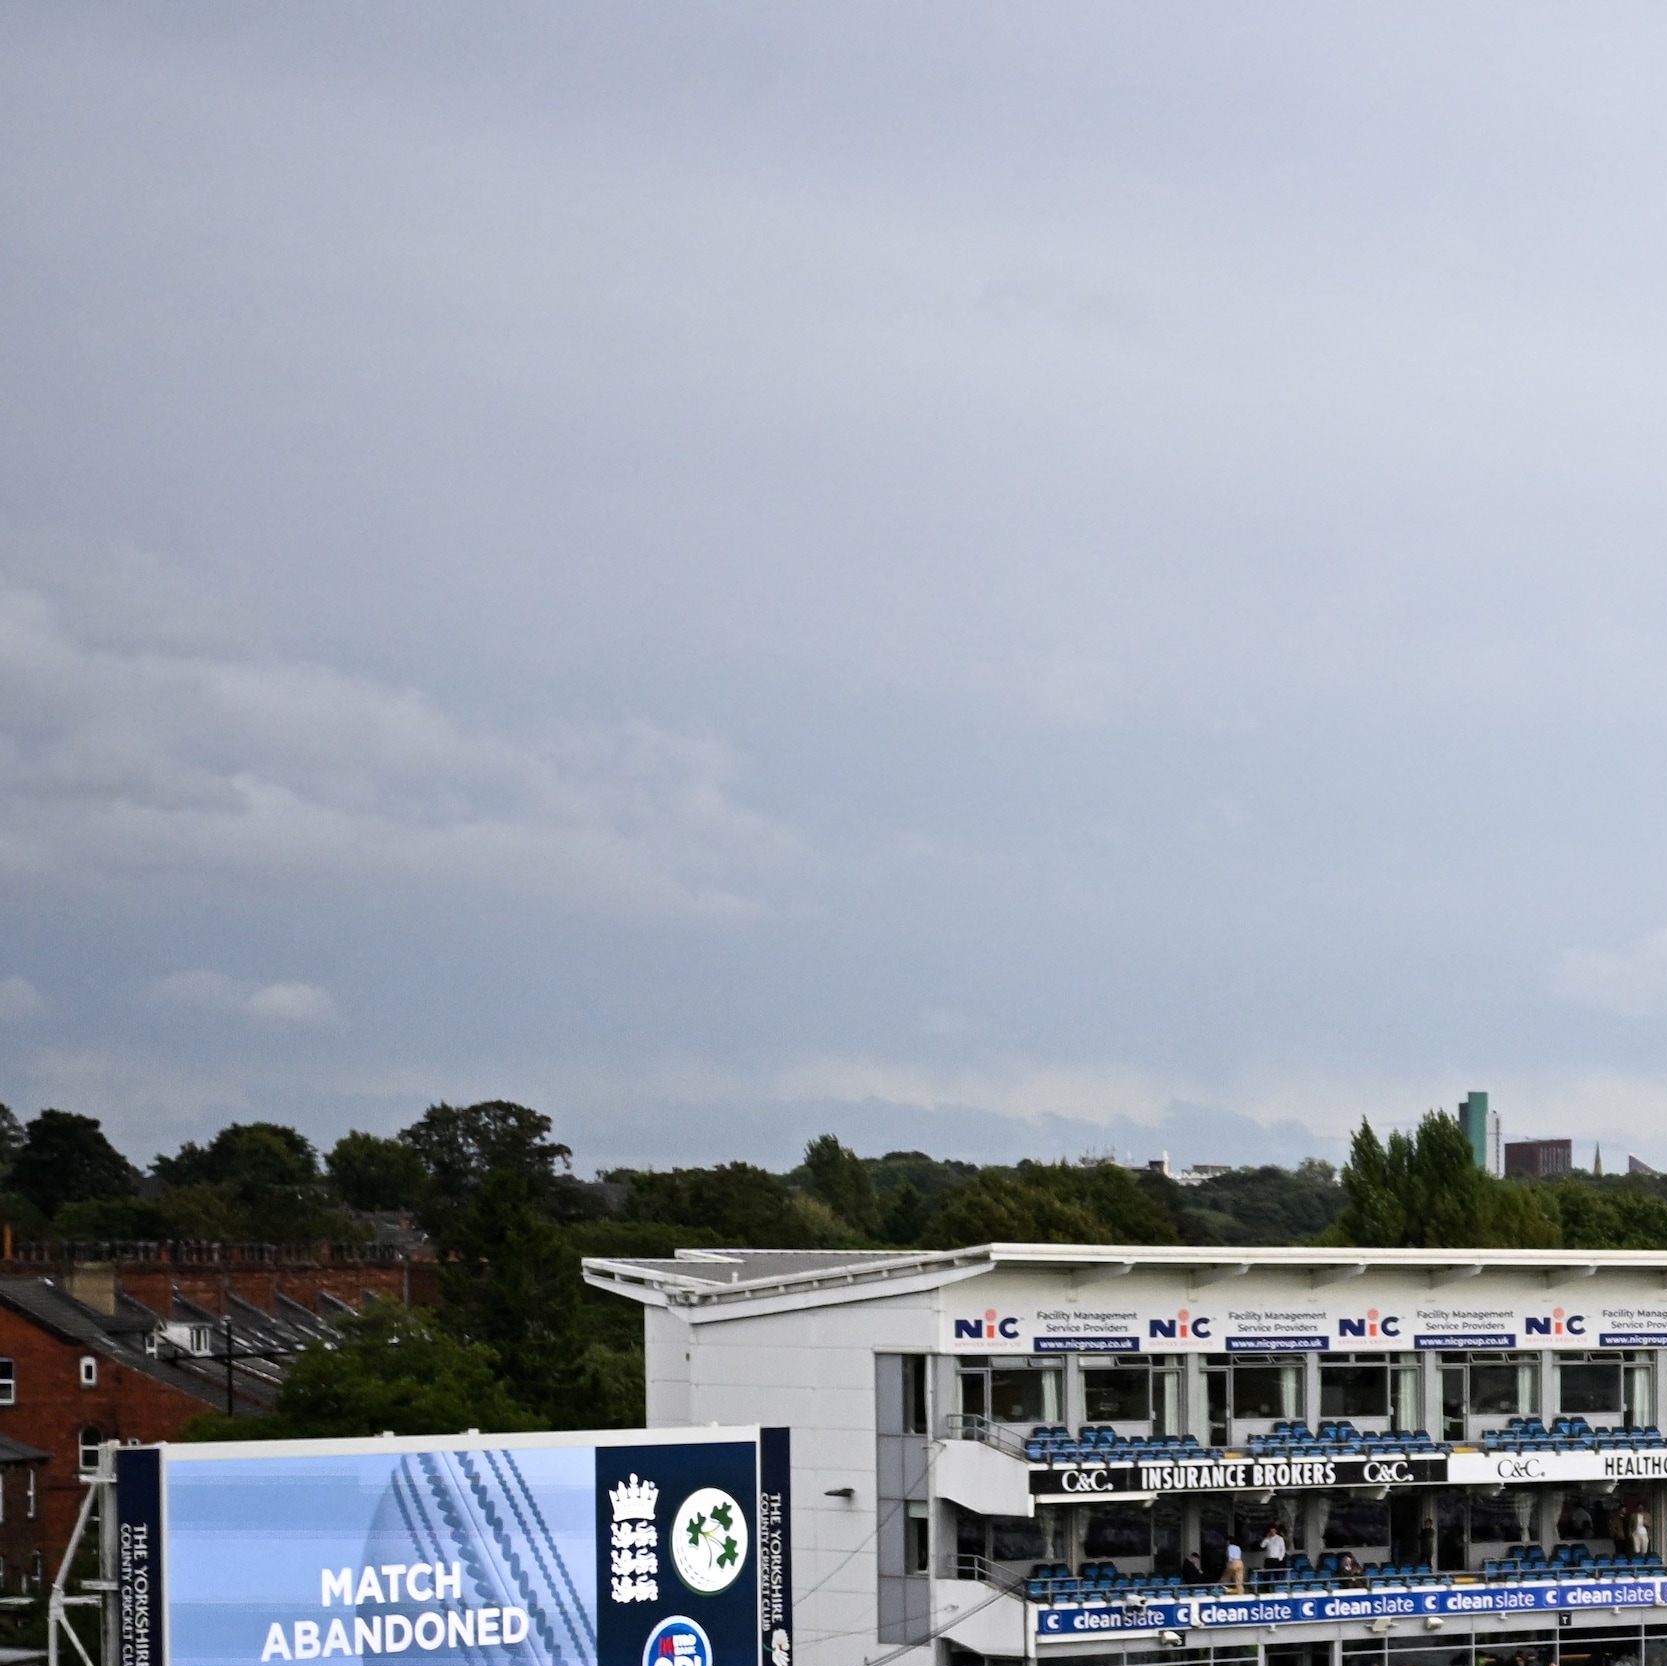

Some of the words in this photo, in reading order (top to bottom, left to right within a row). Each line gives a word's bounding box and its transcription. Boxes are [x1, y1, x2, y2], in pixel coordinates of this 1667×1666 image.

[1142, 1466, 1246, 1490] INSURANCE
[1253, 1463, 1337, 1487] BROKERS
[770, 1492, 782, 1525] THE
[120, 1523, 133, 1583] COUNTY
[133, 1523, 147, 1560] THE
[322, 1561, 462, 1607] MATCH
[771, 1529, 784, 1623] YORKSHIRE
[121, 1585, 133, 1642] CRICKET
[1324, 1600, 1372, 1618] clean
[1374, 1597, 1414, 1616] slate
[260, 1607, 530, 1662] ABANDONED
